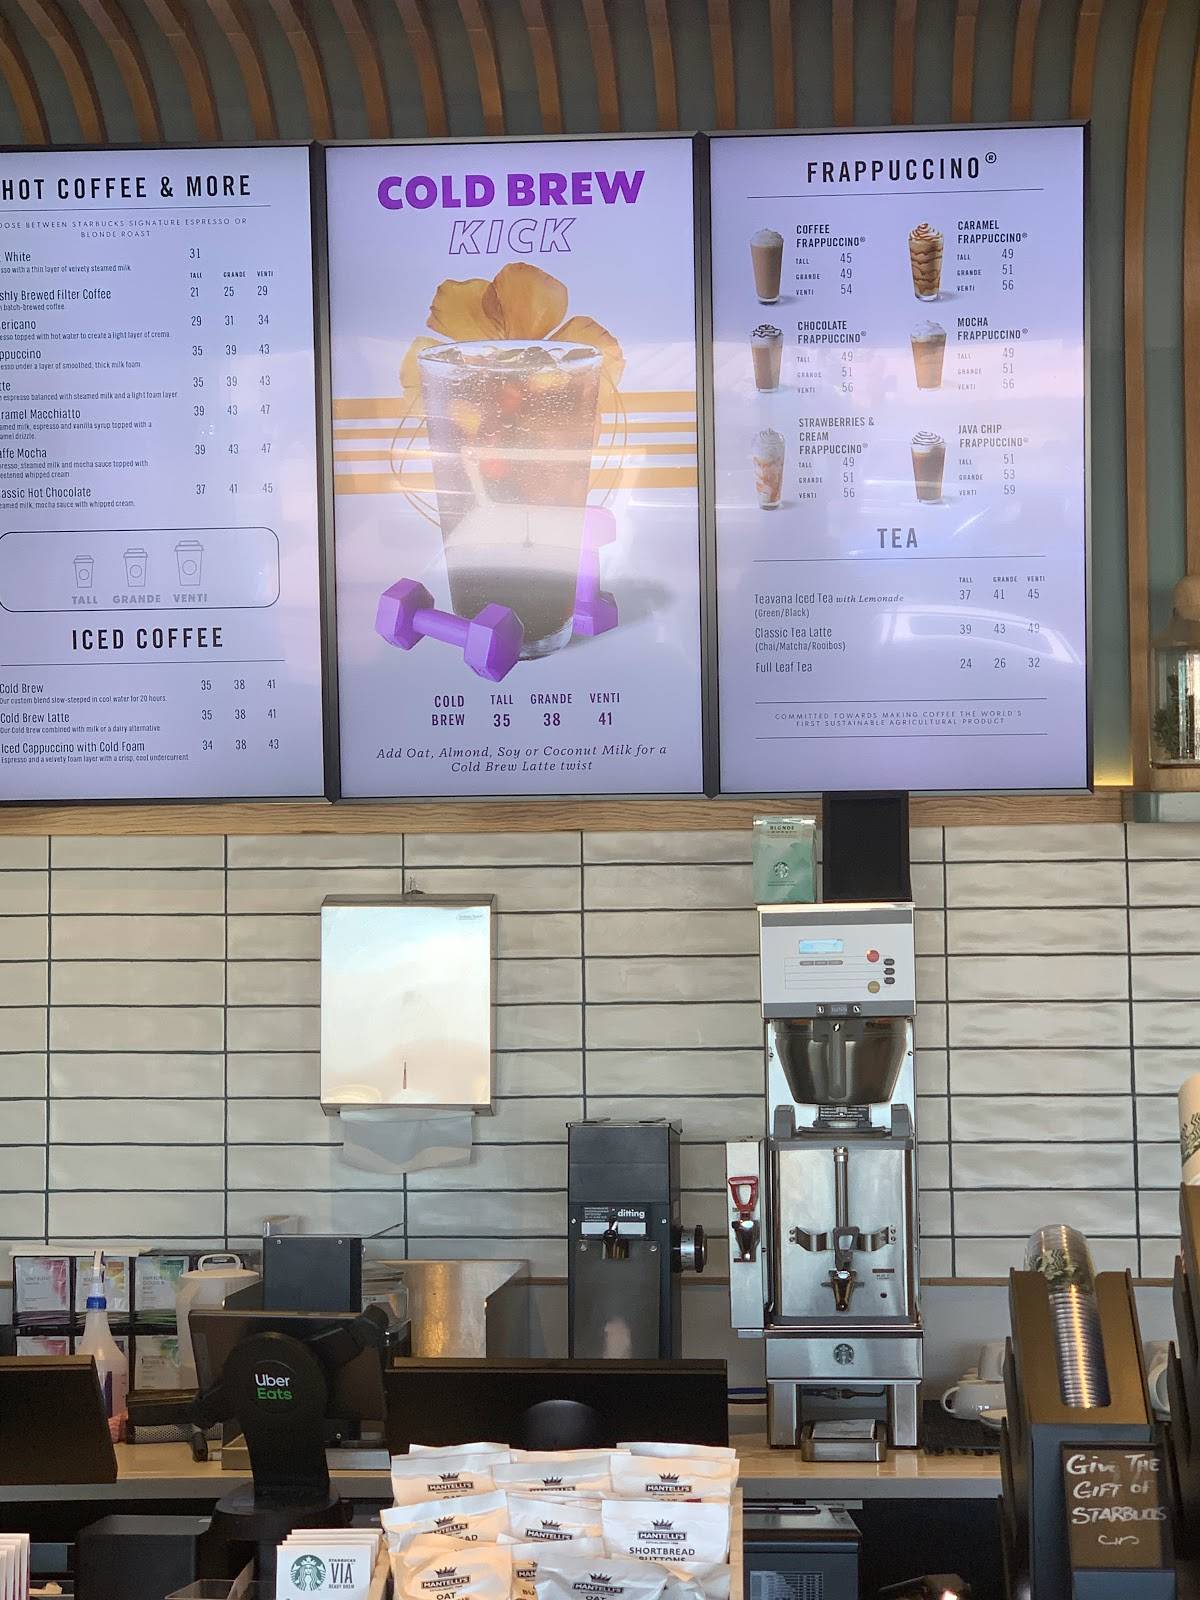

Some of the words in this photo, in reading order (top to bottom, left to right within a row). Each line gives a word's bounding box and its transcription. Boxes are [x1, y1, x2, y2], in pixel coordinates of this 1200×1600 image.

[2, 179, 44, 200] HOT
[58, 177, 147, 199] COFFEE
[160, 176, 173, 197] &
[186, 175, 250, 197] MORE
[377, 175, 495, 210] COLD
[507, 170, 645, 207] BREW
[72, 220, 124, 228] STARBUCKS
[129, 219, 180, 227] SIGNATURE
[185, 218, 230, 226] ESPRESSO
[796, 224, 830, 234] COFFEE
[958, 220, 999, 230] CARAMEL
[121, 230, 150, 238] ROAST
[448, 217, 577, 255] KICK
[4, 251, 31, 262] White
[189, 248, 200, 259] 31
[840, 252, 852, 264] 45
[840, 268, 852, 279] 49
[21, 289, 55, 301] Brewed
[57, 289, 80, 300] Filter
[83, 288, 111, 300] Coffee
[190, 287, 199, 298] 21
[223, 286, 234, 297] 25
[257, 285, 268, 296] 29
[841, 283, 852, 294] 54
[797, 320, 847, 331] CHOCOLATE
[957, 317, 988, 327] MOCHA
[30, 408, 81, 420] Macchiatto
[798, 417, 865, 428] STRAWBERRIES
[868, 416, 875, 426] &
[958, 424, 978, 434] JAVA
[981, 424, 1002, 434] CHIP
[799, 431, 829, 442] CREAM
[17, 448, 47, 459] Mocha
[28, 488, 43, 498] Hot
[45, 486, 91, 498] Chocolate
[877, 528, 918, 549] TEA
[71, 595, 98, 605] TALL
[112, 594, 161, 604] GRANDE
[173, 593, 207, 603] VENTI
[754, 594, 792, 604] Teavana
[795, 593, 815, 604] Iced
[817, 593, 833, 604] Tea
[836, 595, 856, 603] with
[857, 594, 904, 603] Lemonade
[959, 589, 971, 600] 37
[993, 589, 1005, 600] 41
[1027, 588, 1039, 599] 45
[72, 629, 124, 650] ICED
[137, 627, 223, 649] COFFEE
[755, 627, 788, 639] Classic
[791, 627, 806, 638] Tea
[809, 627, 832, 638] Latte
[756, 662, 772, 673] Full
[775, 661, 794, 673] Leaf
[797, 661, 812, 672] Tea
[960, 658, 972, 669] 24
[994, 657, 1006, 669] 26
[1028, 657, 1040, 668] 32
[0, 683, 19, 694] Cold
[22, 683, 44, 694] Brew
[201, 679, 212, 691] 35
[234, 679, 245, 690] 38
[267, 679, 276, 689] 41
[434, 695, 464, 708] COLD
[490, 694, 514, 705] TALL
[530, 693, 572, 705] GRANDE
[589, 692, 620, 703] VENTI
[0, 713, 20, 724] Cold
[22, 713, 45, 723] Brew
[47, 712, 70, 723] Latte
[432, 714, 465, 726] BREW
[493, 713, 510, 727] 35
[543, 712, 561, 726] 38
[598, 712, 612, 725] 41
[962, 717, 1004, 725] PRODUCT
[1, 743, 20, 754] Iced
[22, 742, 74, 755] Cappuccino
[77, 742, 97, 752] with
[99, 741, 119, 752] Cold
[122, 741, 145, 752] Foam
[376, 748, 402, 759] Add
[406, 748, 434, 759] Oat,
[438, 746, 492, 758] Almond,
[497, 746, 521, 759] Soy
[525, 748, 539, 757] or
[543, 746, 597, 756] Coconut
[601, 744, 632, 755] Milk
[634, 744, 655, 757] for
[451, 761, 480, 772] Cold
[484, 761, 517, 772] Brew
[522, 761, 556, 771] Latte
[560, 760, 592, 771] twist
[617, 1209, 645, 1219] ditting
[255, 1373, 290, 1387] Uber
[257, 1387, 292, 1401] Eats
[629, 1547, 695, 1556] SHORTBREAD
[331, 1563, 353, 1584] VIA
[436, 1592, 456, 1600] OAT
